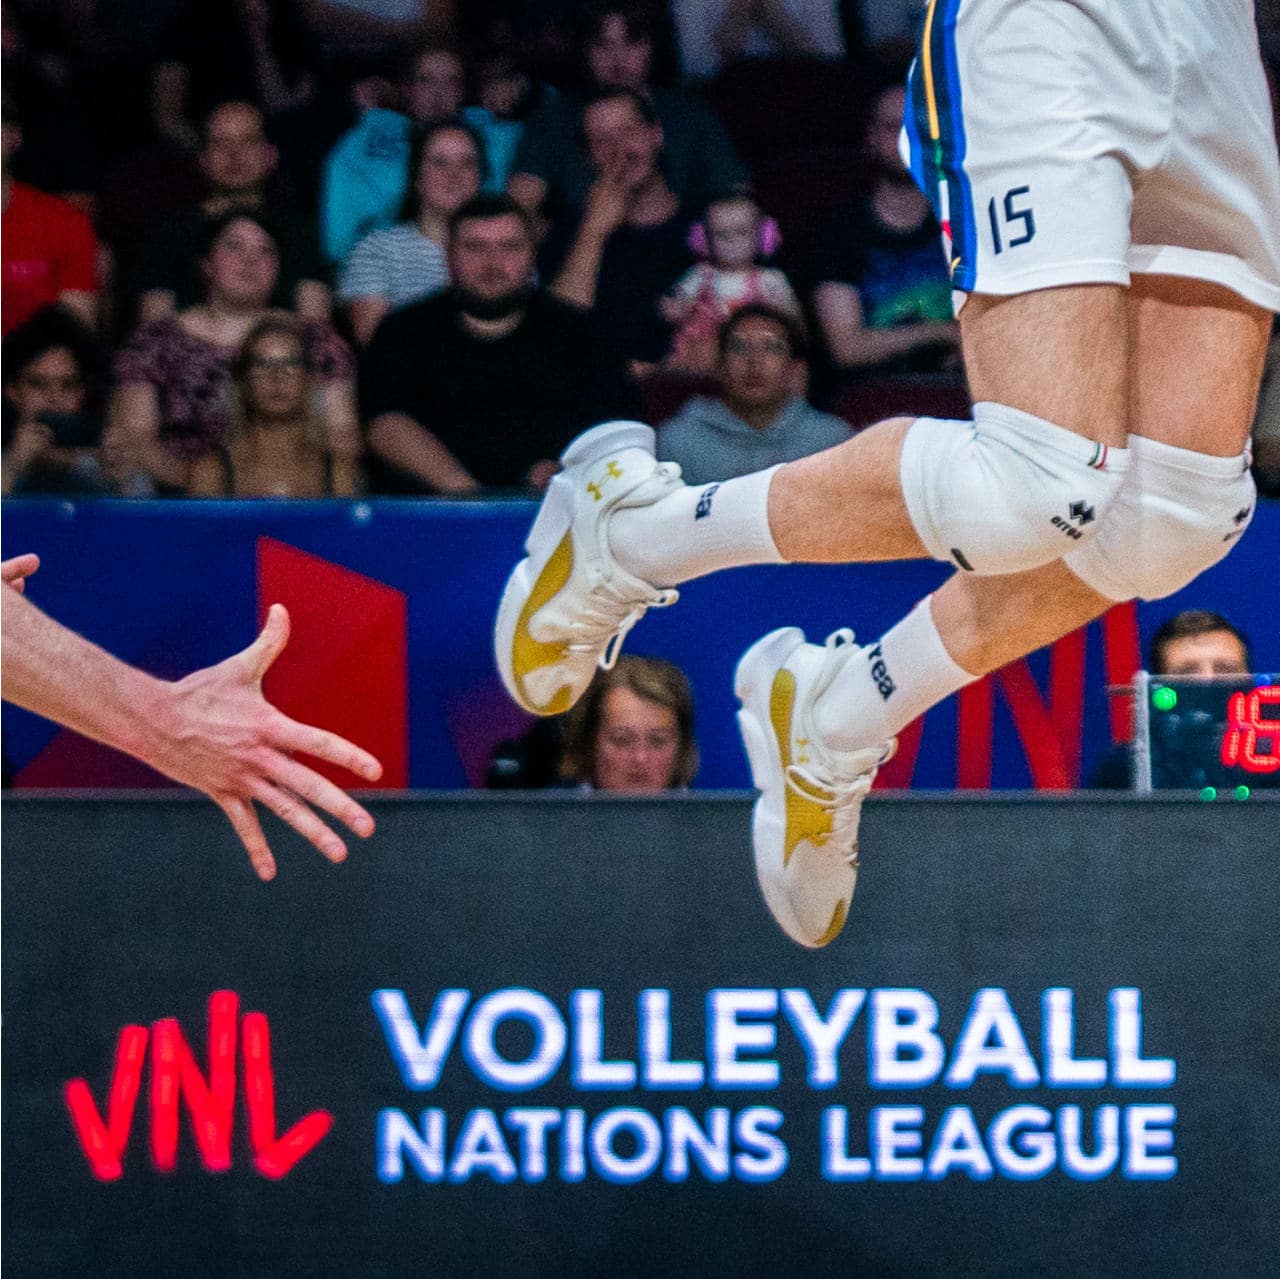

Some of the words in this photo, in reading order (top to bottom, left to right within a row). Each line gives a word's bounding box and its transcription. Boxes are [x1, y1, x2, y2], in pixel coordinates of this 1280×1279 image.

[988, 184, 1036, 256] 15
[371, 986, 1178, 1089] VOLLEYBALL
[65, 989, 334, 1181] VNL
[374, 1105, 789, 1183] NATIONS
[819, 1105, 1179, 1183] LEAGUE
